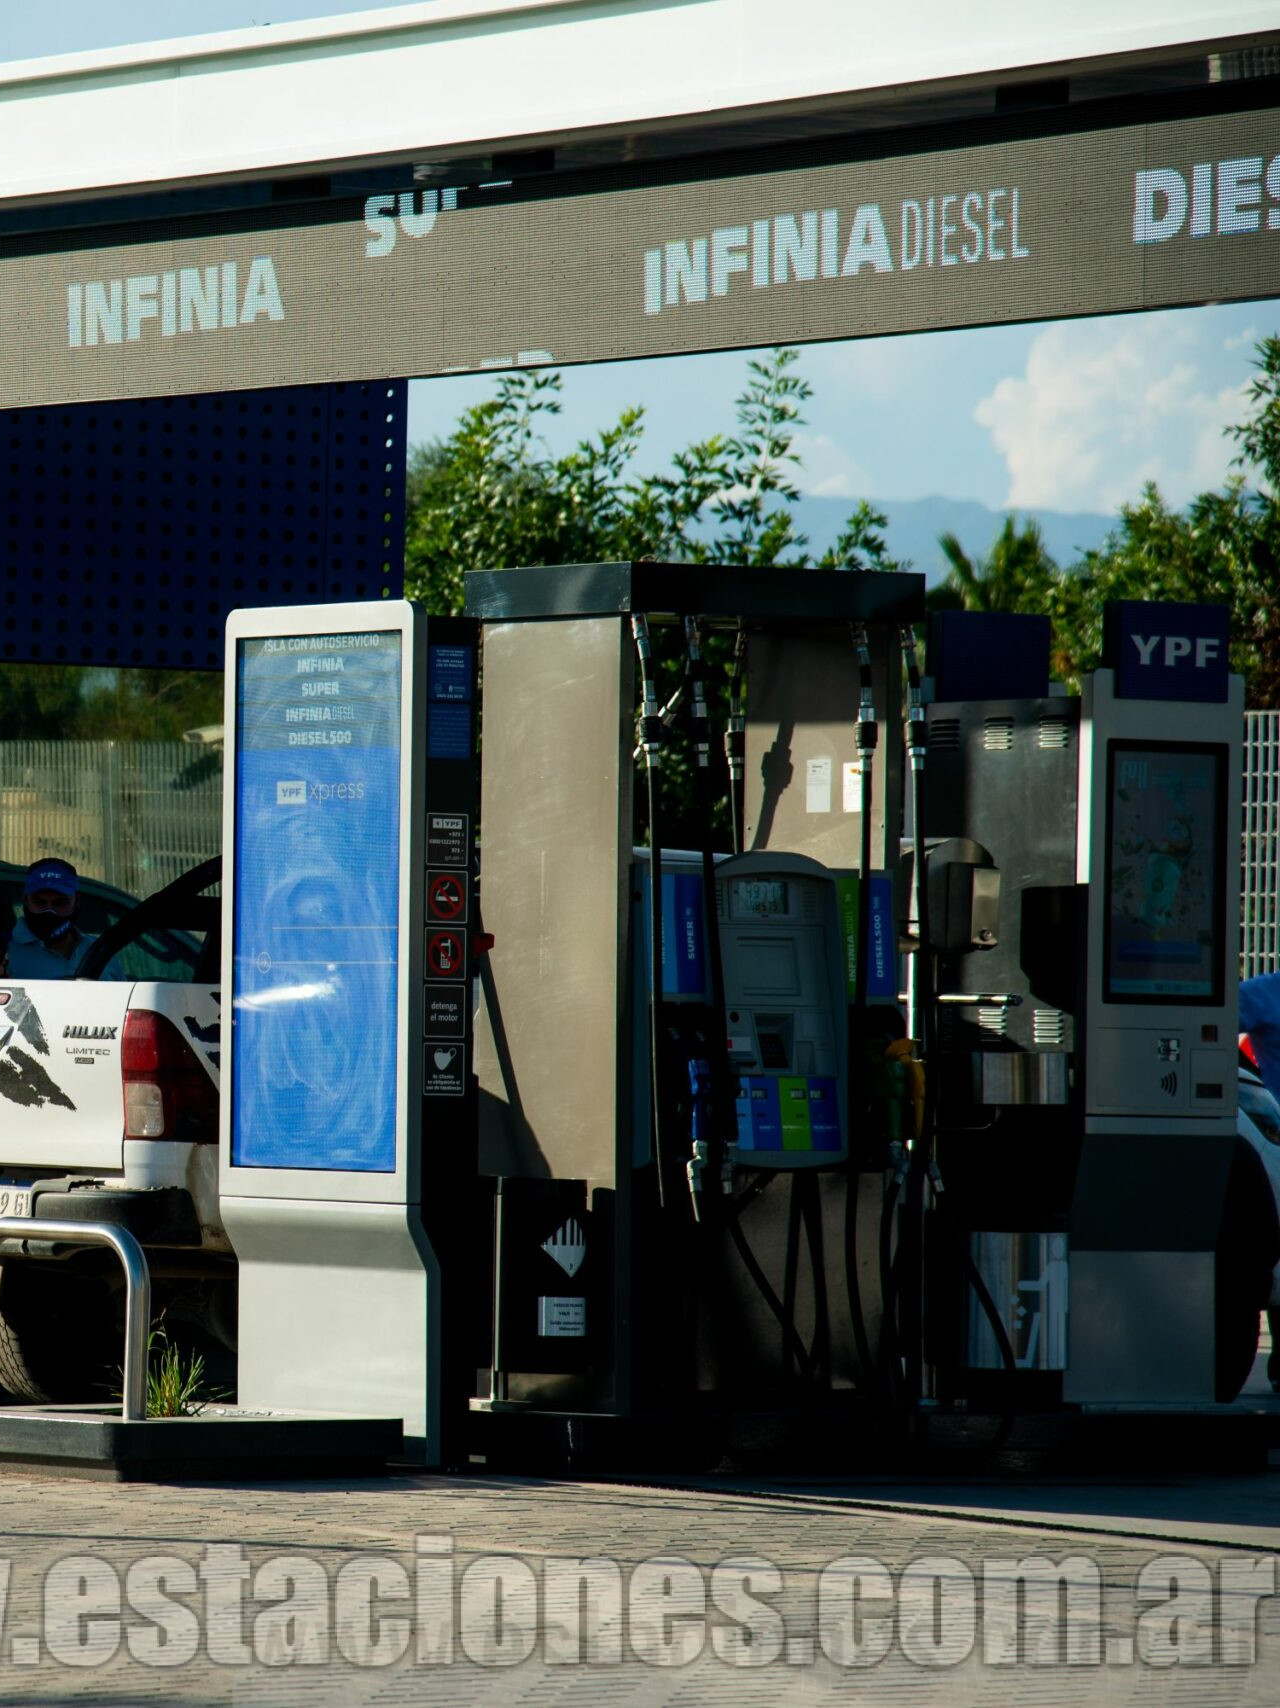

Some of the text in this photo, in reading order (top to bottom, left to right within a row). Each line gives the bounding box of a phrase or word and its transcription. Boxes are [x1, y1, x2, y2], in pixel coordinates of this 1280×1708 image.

[643, 187, 1031, 315] INFINIA DIESEL
[66, 256, 285, 348] INFINIA
[264, 634, 380, 653] ISLA CON AUTOSERVICIO
[1130, 633, 1220, 668] YPF
[297, 657, 345, 673] INFINIA
[301, 681, 340, 697] SUPER
[285, 707, 332, 722] INFINIA
[281, 782, 365, 807] YPF xpress
[39, 871, 62, 879] YPF
[686, 921, 696, 960] SUPER
[847, 935, 857, 983] INFINIA
[431, 1001, 458, 1012] detenga
[430, 1012, 458, 1021] el motor
[62, 1025, 118, 1039] HILUX
